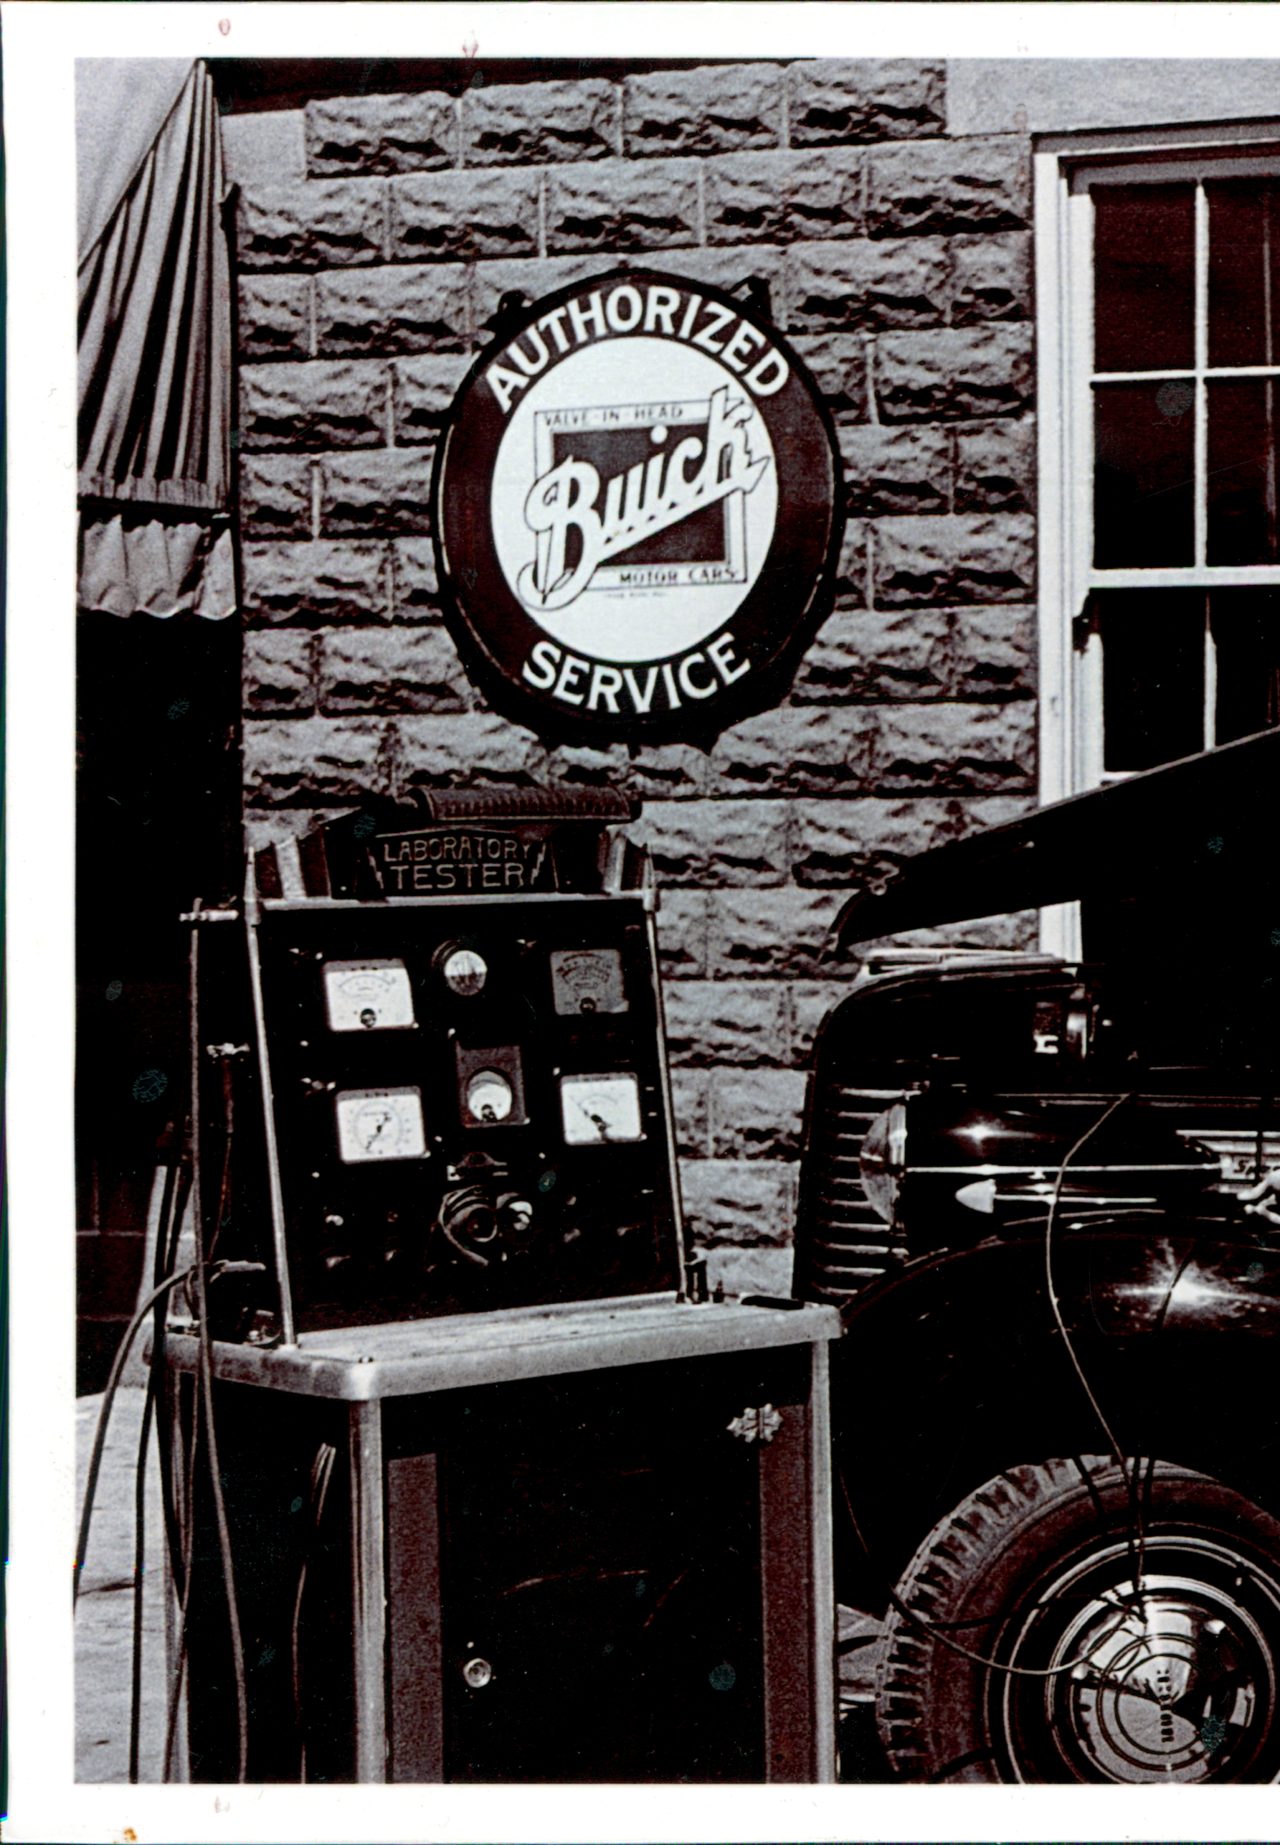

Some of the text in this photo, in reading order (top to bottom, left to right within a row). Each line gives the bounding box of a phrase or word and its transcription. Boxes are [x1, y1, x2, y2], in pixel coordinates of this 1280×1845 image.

[485, 285, 789, 413] AUTHORIZED
[517, 385, 771, 610] Buick
[619, 567, 737, 585] MOTOR CARS
[522, 632, 751, 713] SERVICE
[383, 836, 530, 862] LABORATORY
[389, 862, 525, 889] TESTER
